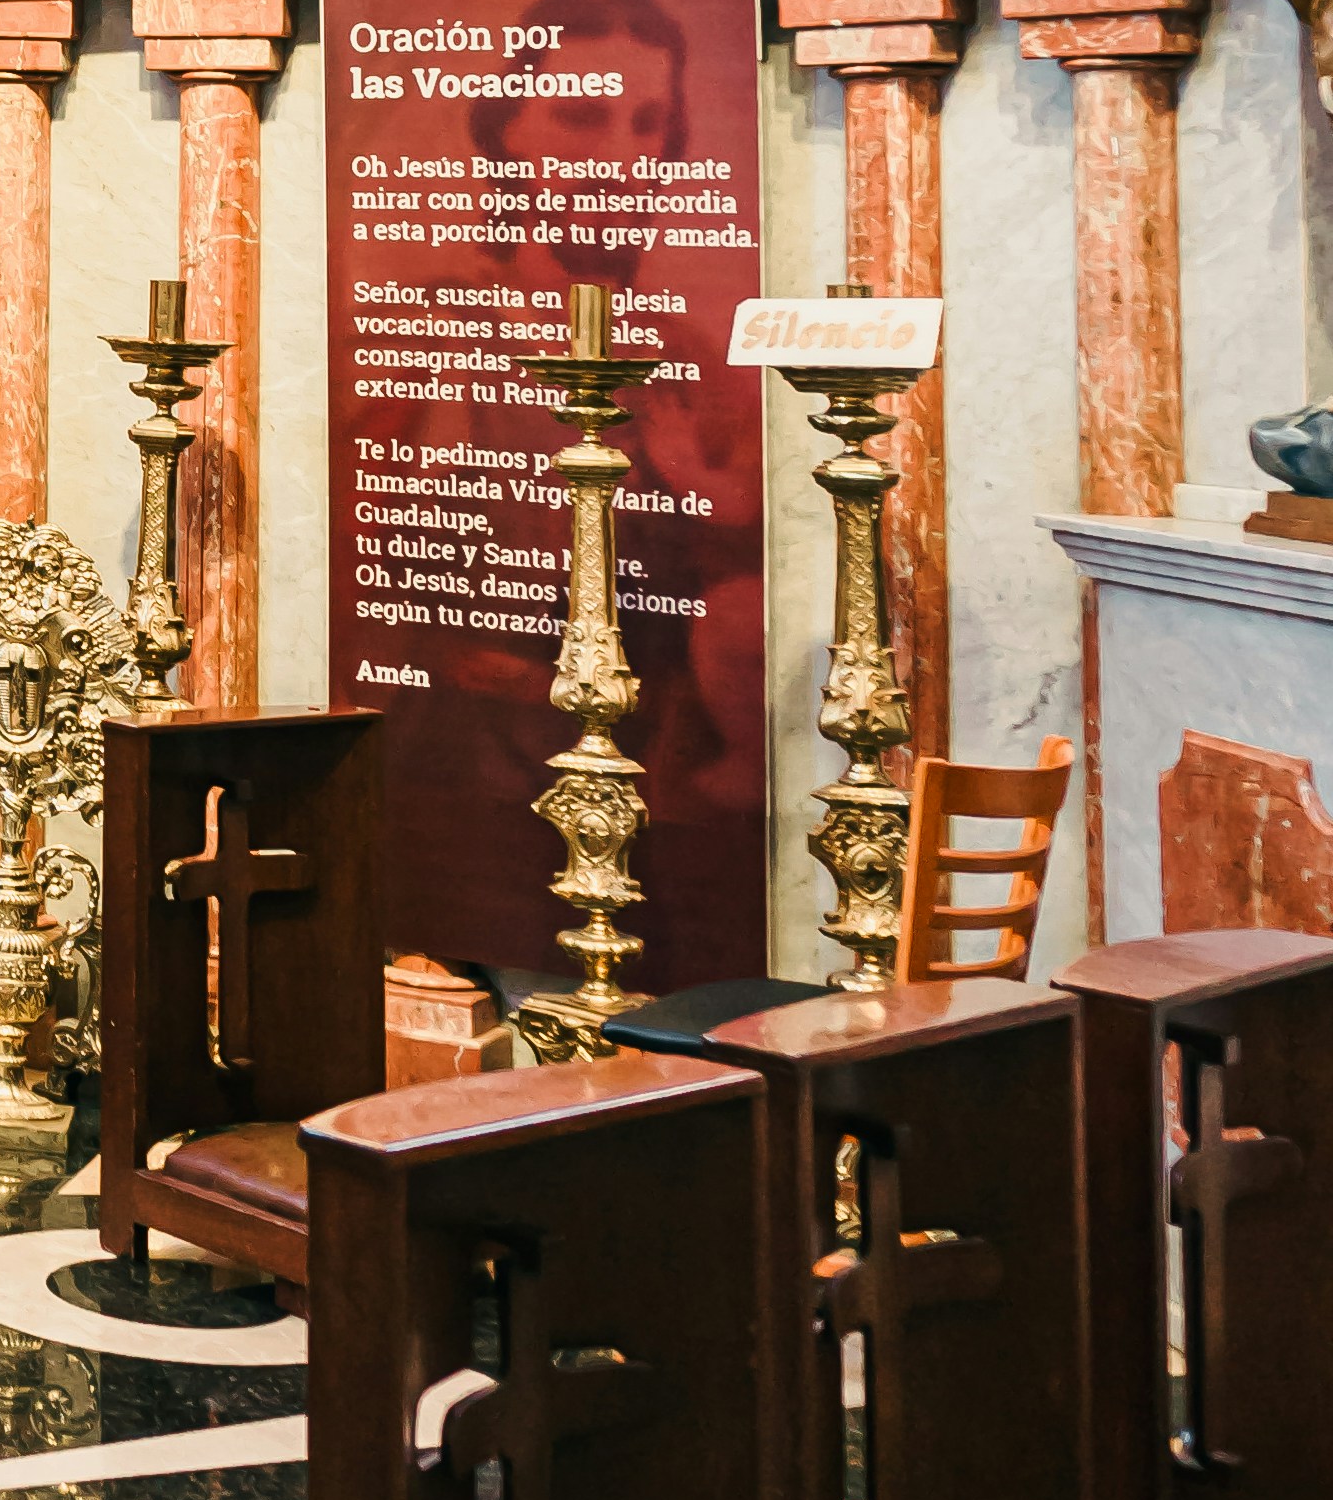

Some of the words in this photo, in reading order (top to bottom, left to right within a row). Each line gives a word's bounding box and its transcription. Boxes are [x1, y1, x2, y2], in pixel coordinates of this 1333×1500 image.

[350, 19, 494, 52] Oración
[502, 26, 564, 57] por
[350, 67, 403, 99] las
[412, 65, 623, 98] Vocaciones
[352, 155, 388, 177] Oh
[394, 157, 465, 178] Jesús
[471, 157, 536, 178] Buen
[542, 157, 626, 183] Pastor,
[632, 156, 731, 180] dígnate
[352, 187, 422, 209] mirar
[428, 193, 473, 210] con
[479, 189, 530, 216] ojos
[536, 188, 566, 211] de
[573, 189, 737, 214] misericordia
[353, 224, 368, 240] a
[374, 221, 425, 241] esta
[431, 219, 527, 247] porción
[533, 220, 563, 243] de
[569, 224, 596, 244] tu
[602, 228, 659, 251] grey
[664, 223, 758, 247] amada.
[354, 281, 429, 308] Señor,
[436, 284, 525, 307] suscita
[532, 291, 563, 309] en
[612, 288, 687, 316] glesia
[354, 314, 493, 338] vocaciones
[740, 309, 917, 351] Silencio
[355, 348, 511, 374] consagradas
[355, 377, 465, 401] extender
[471, 382, 497, 403] tu
[355, 439, 384, 460] Te
[391, 439, 413, 462] lo
[420, 442, 527, 469] pedimos
[356, 470, 503, 500] Inmaculada
[681, 491, 712, 516] de
[356, 502, 493, 536] Guadalupe,
[356, 534, 381, 555] tu
[388, 534, 455, 560] dulce
[462, 545, 477, 567] y
[484, 543, 556, 569] Santa
[356, 564, 391, 587] Oh
[398, 568, 475, 598] Jesús,
[481, 574, 557, 602] danos
[357, 601, 431, 625] según
[438, 605, 463, 626] tu
[356, 660, 430, 687] Amén
